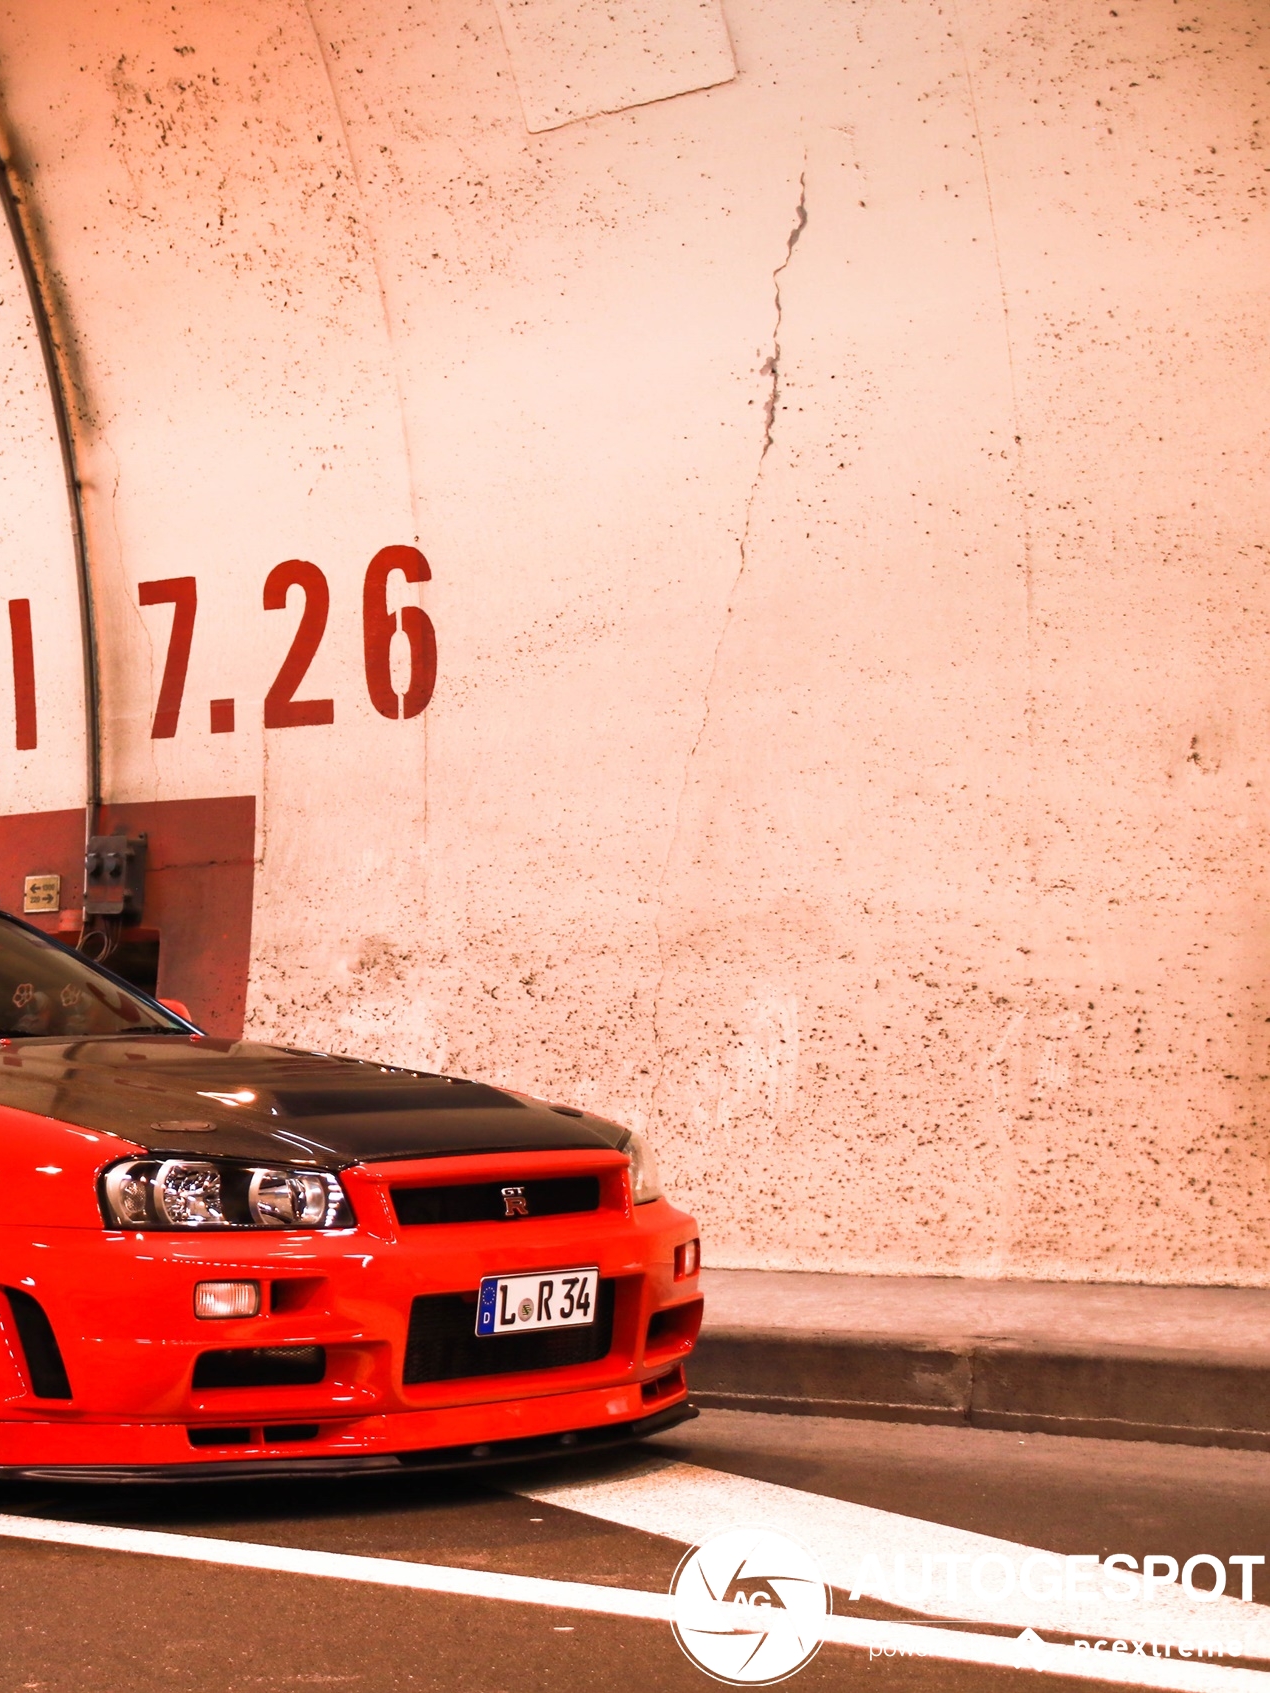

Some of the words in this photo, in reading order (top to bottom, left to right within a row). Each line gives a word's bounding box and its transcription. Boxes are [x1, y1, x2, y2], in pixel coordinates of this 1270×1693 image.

[138, 545, 437, 739] 7.26
[483, 1312, 491, 1324] D
[500, 1284, 516, 1326] L
[537, 1280, 554, 1322] R
[560, 1276, 591, 1319] 34
